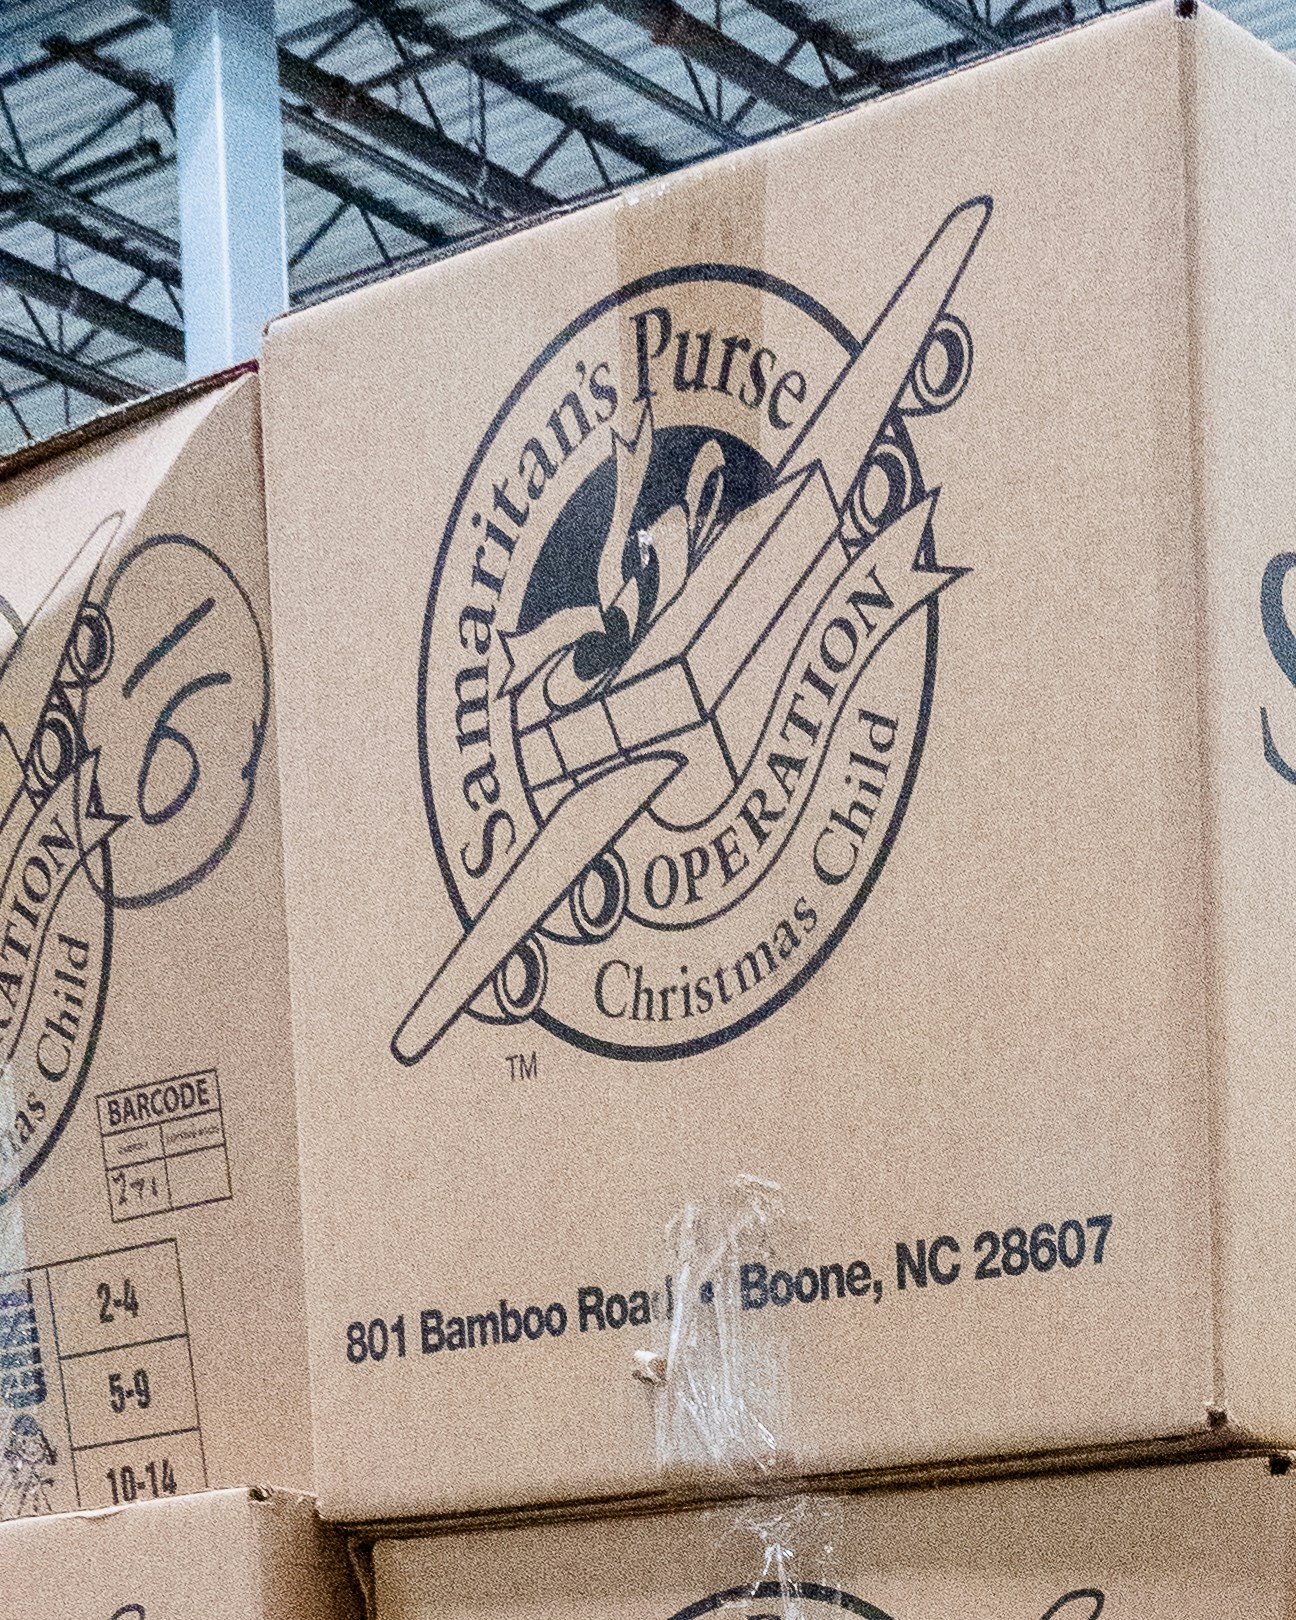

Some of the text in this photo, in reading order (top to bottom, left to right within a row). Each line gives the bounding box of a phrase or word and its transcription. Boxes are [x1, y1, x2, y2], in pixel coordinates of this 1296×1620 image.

[460, 306, 808, 880] Samaritan's Purse
[644, 570, 895, 910] OPERATION
[0, 815, 77, 1055] ATION
[594, 709, 900, 1024] Christmas Child
[36, 932, 90, 1082] Child
[106, 1077, 211, 1127] BARCODE
[97, 1279, 139, 1324] 2-4
[346, 1315, 406, 1365] 801
[421, 1299, 569, 1357] Bamboo
[740, 1257, 885, 1312] Boone,
[895, 1234, 963, 1289] NC
[973, 1215, 1116, 1282] 28607
[108, 1369, 151, 1414] 5-9
[106, 1459, 178, 1506] 10-14
